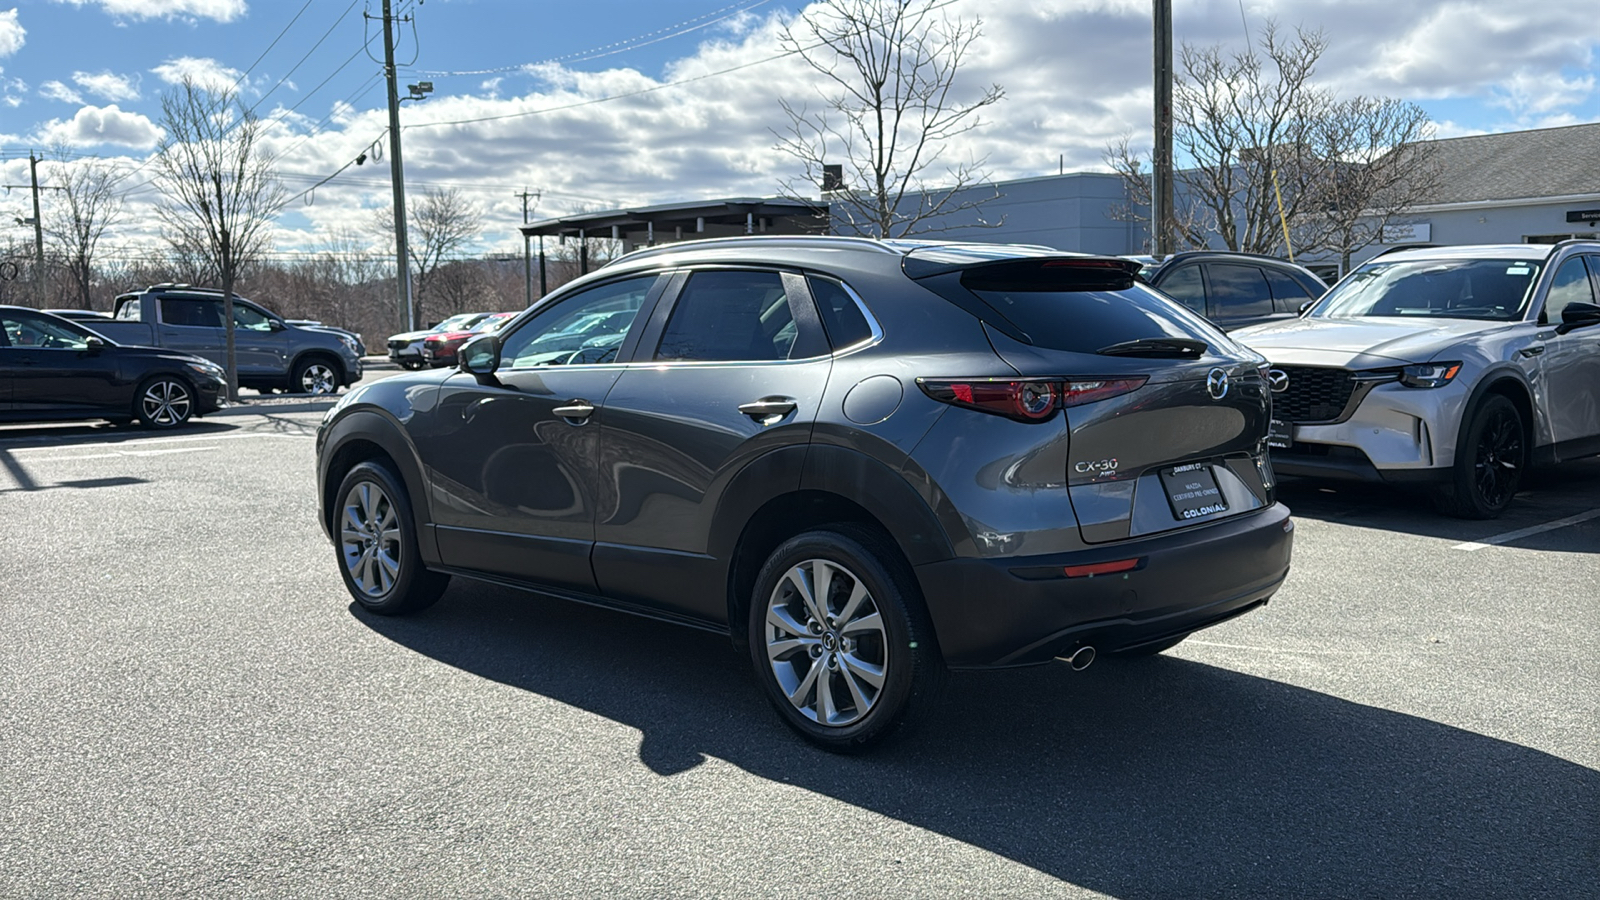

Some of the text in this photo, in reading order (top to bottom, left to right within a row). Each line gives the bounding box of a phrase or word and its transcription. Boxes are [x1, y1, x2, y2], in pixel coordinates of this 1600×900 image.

[1075, 458, 1118, 473] CX-30
[1173, 464, 1196, 473] DANBURY
[1099, 470, 1116, 478] AWD
[1185, 482, 1202, 490] MAZDA
[1173, 487, 1219, 501] CERTIFIED PRE-OWNED
[1183, 503, 1226, 518] COLONIAL
